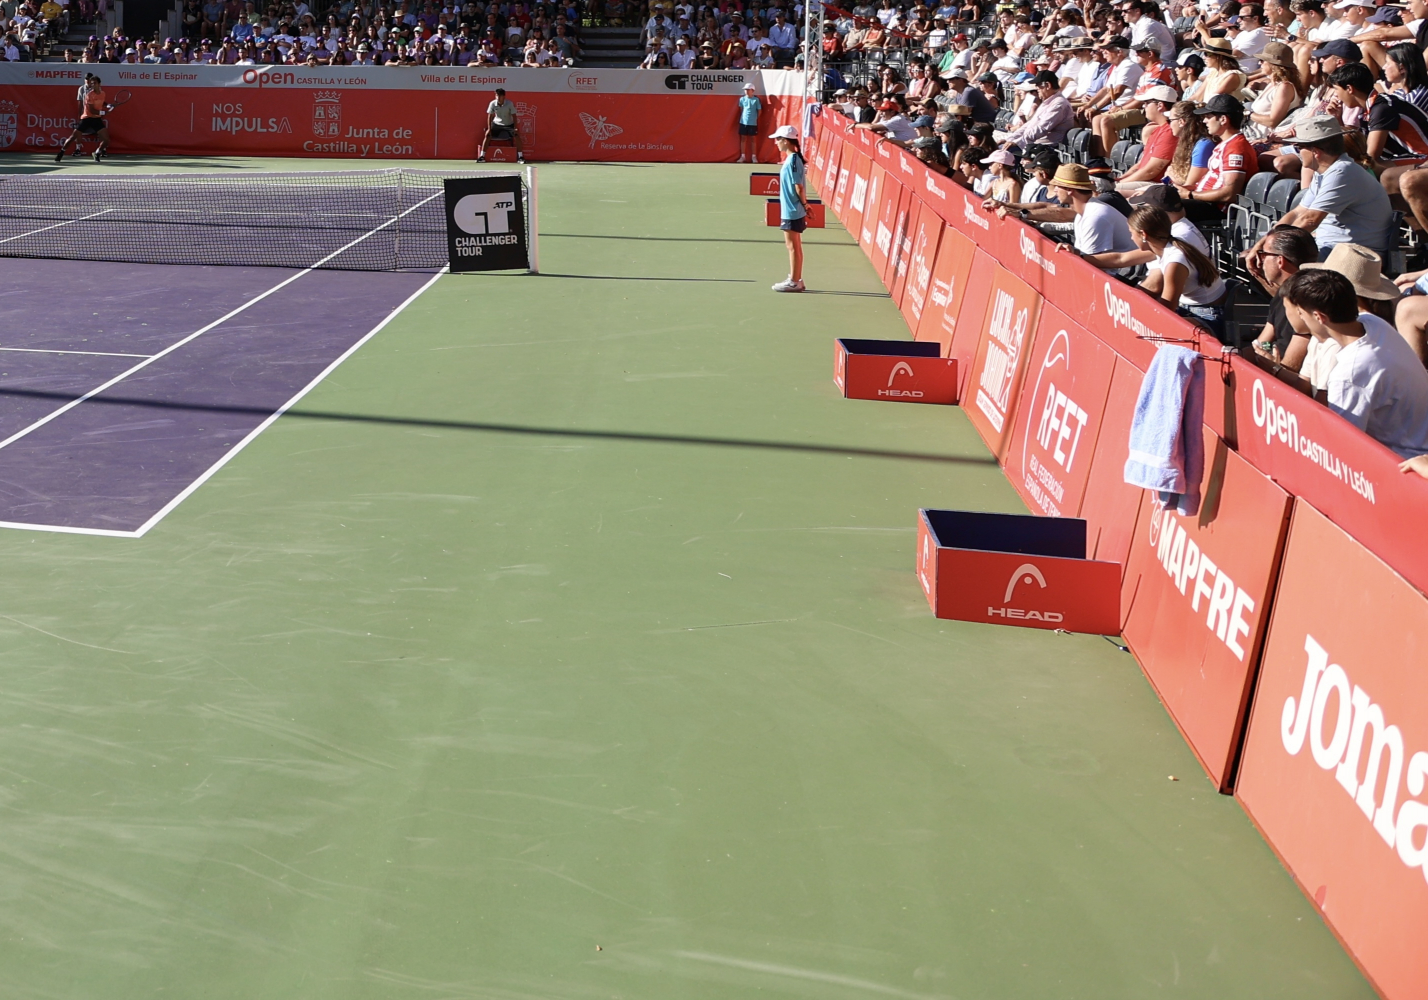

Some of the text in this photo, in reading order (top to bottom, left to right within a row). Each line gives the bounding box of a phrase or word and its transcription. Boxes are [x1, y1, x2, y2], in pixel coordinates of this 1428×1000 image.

[36, 71, 82, 79] MAPFRE
[118, 72, 198, 82] Villa de El Espinar
[243, 69, 294, 88] Open
[297, 77, 335, 85] CASTILLA
[344, 77, 367, 85] LEÓN
[420, 74, 507, 85] Villa de El Espinar
[690, 74, 744, 83] CHALLENGER
[576, 77, 598, 85] RFET
[690, 82, 714, 90] TOUR
[212, 103, 243, 114] NOS
[344, 126, 412, 139] Junta de
[25, 133, 45, 146] de
[303, 140, 412, 157] Castilla y León
[601, 142, 626, 150] Reserva
[493, 201, 513, 209] ATP
[455, 235, 518, 247] CHALLENGER
[456, 246, 483, 257] TOUR
[1104, 282, 1131, 330] Open
[878, 389, 924, 398] HEAD
[1036, 382, 1088, 473] RFET
[1252, 378, 1376, 505] Open CASTILLA Y LEÓN
[1157, 510, 1255, 662] MAPFRE
[987, 606, 1064, 623] HEAD
